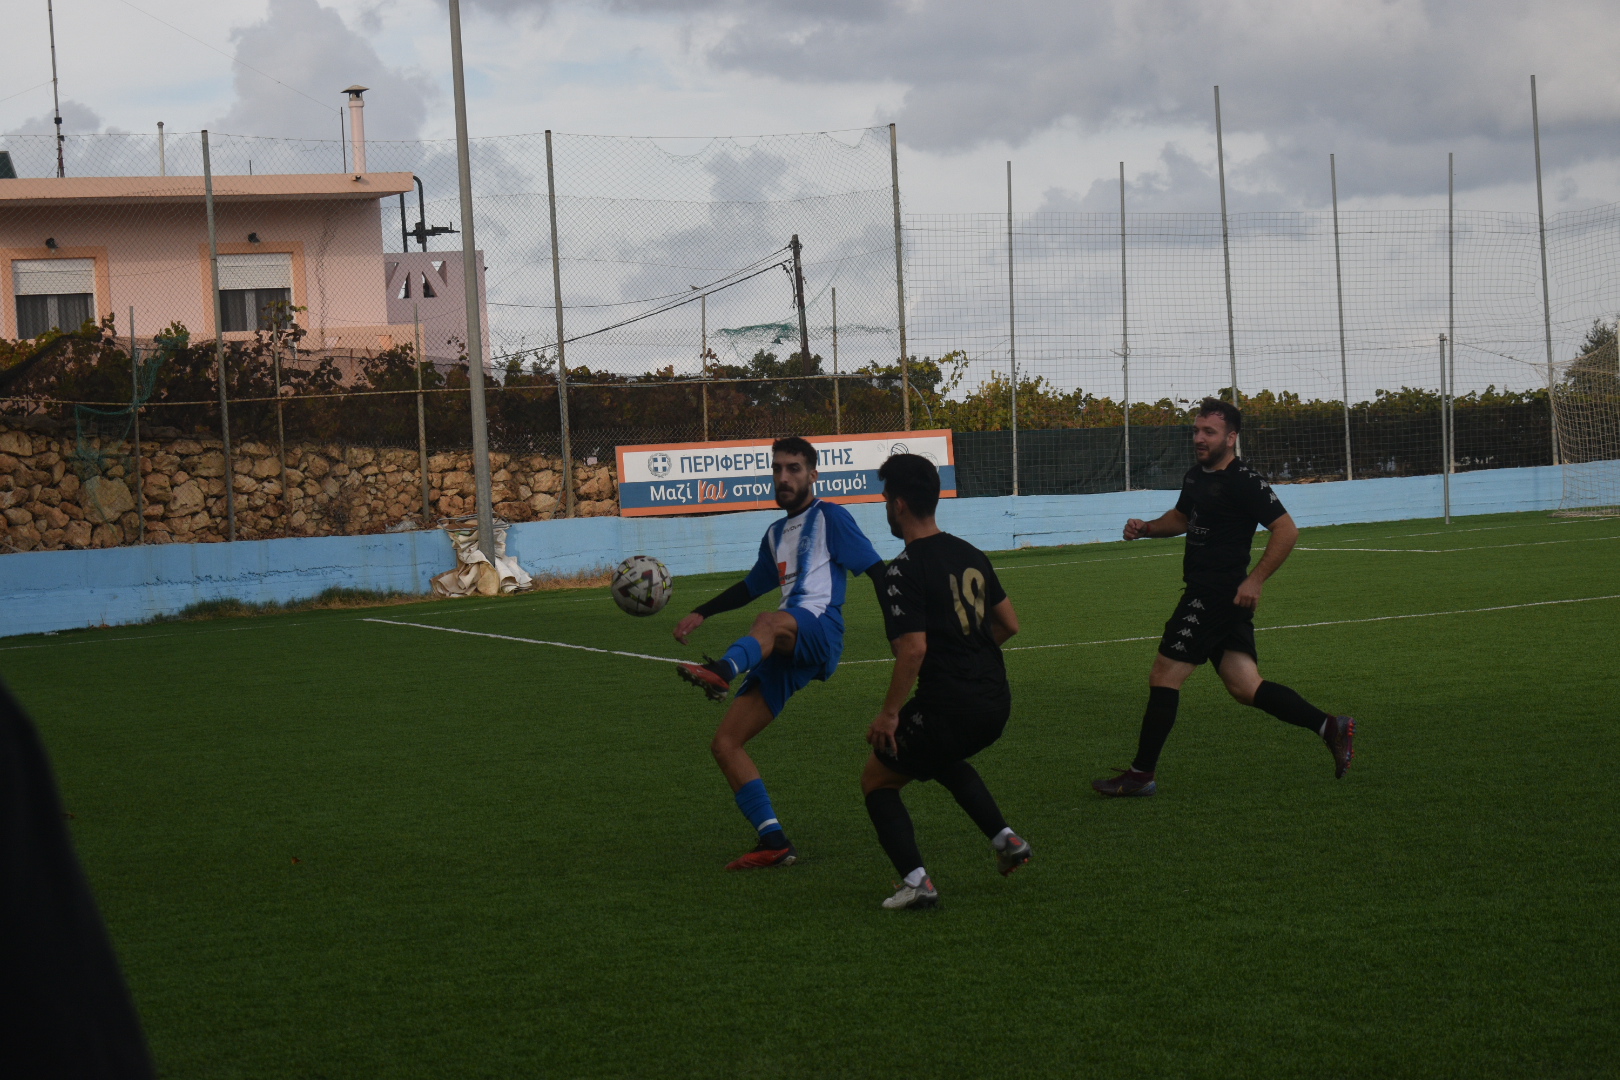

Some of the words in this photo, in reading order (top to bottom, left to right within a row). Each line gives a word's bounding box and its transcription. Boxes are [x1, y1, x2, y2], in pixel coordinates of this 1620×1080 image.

[680, 452, 772, 473] ΠΕΡΙΦΕΡΕΙ
[650, 482, 693, 504] Μαζί
[732, 483, 772, 497] στον
[812, 473, 867, 496] τισμό!
